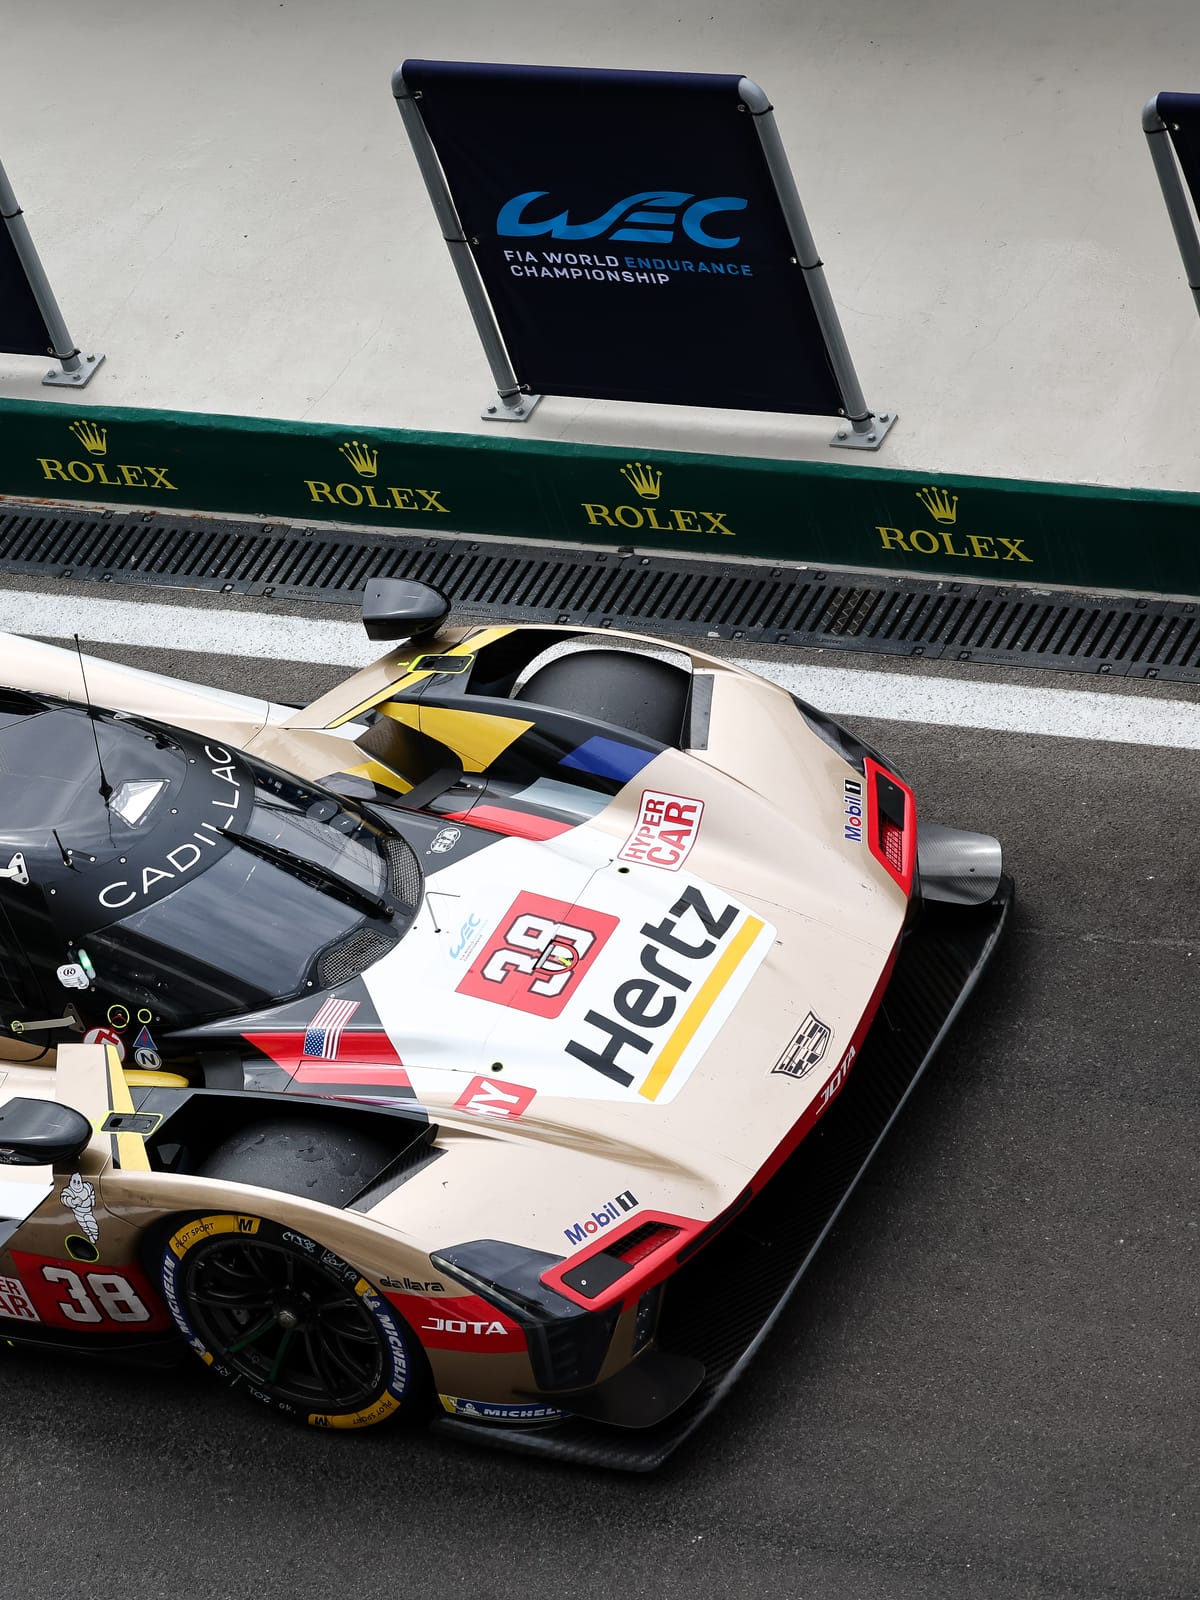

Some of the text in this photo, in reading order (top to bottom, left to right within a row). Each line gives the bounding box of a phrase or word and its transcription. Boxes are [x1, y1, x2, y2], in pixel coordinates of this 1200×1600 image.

[496, 190, 748, 249] WEC
[503, 250, 754, 277] FIA WORLD ENDURANCE
[509, 265, 670, 285] CHAMPIONSHIP
[36, 457, 179, 491] ROLEX
[307, 480, 452, 514] ROLEX
[580, 502, 737, 537] ROLEX
[874, 526, 1035, 563] ROLEX
[98, 744, 241, 909] CADILLAC
[624, 798, 665, 860] HYPER
[646, 801, 698, 865] CAR
[844, 795, 862, 842] Mobil
[564, 885, 740, 1088] Hertz
[140, 1052, 156, 1066] N
[815, 1044, 856, 1116] JOTA
[174, 1222, 215, 1249] PILOT SPORT
[237, 1219, 253, 1231] M
[564, 1201, 621, 1246] Mobil
[41, 1265, 151, 1324] 38
[160, 1255, 192, 1336] MICHELIN
[379, 1275, 446, 1293] dallara
[421, 1316, 509, 1336] JOTA
[376, 1311, 407, 1394] MICHELIN
[313, 1415, 329, 1427] M
[352, 1399, 394, 1426] PILOT SPORT
[482, 1407, 563, 1418] MICHEL
